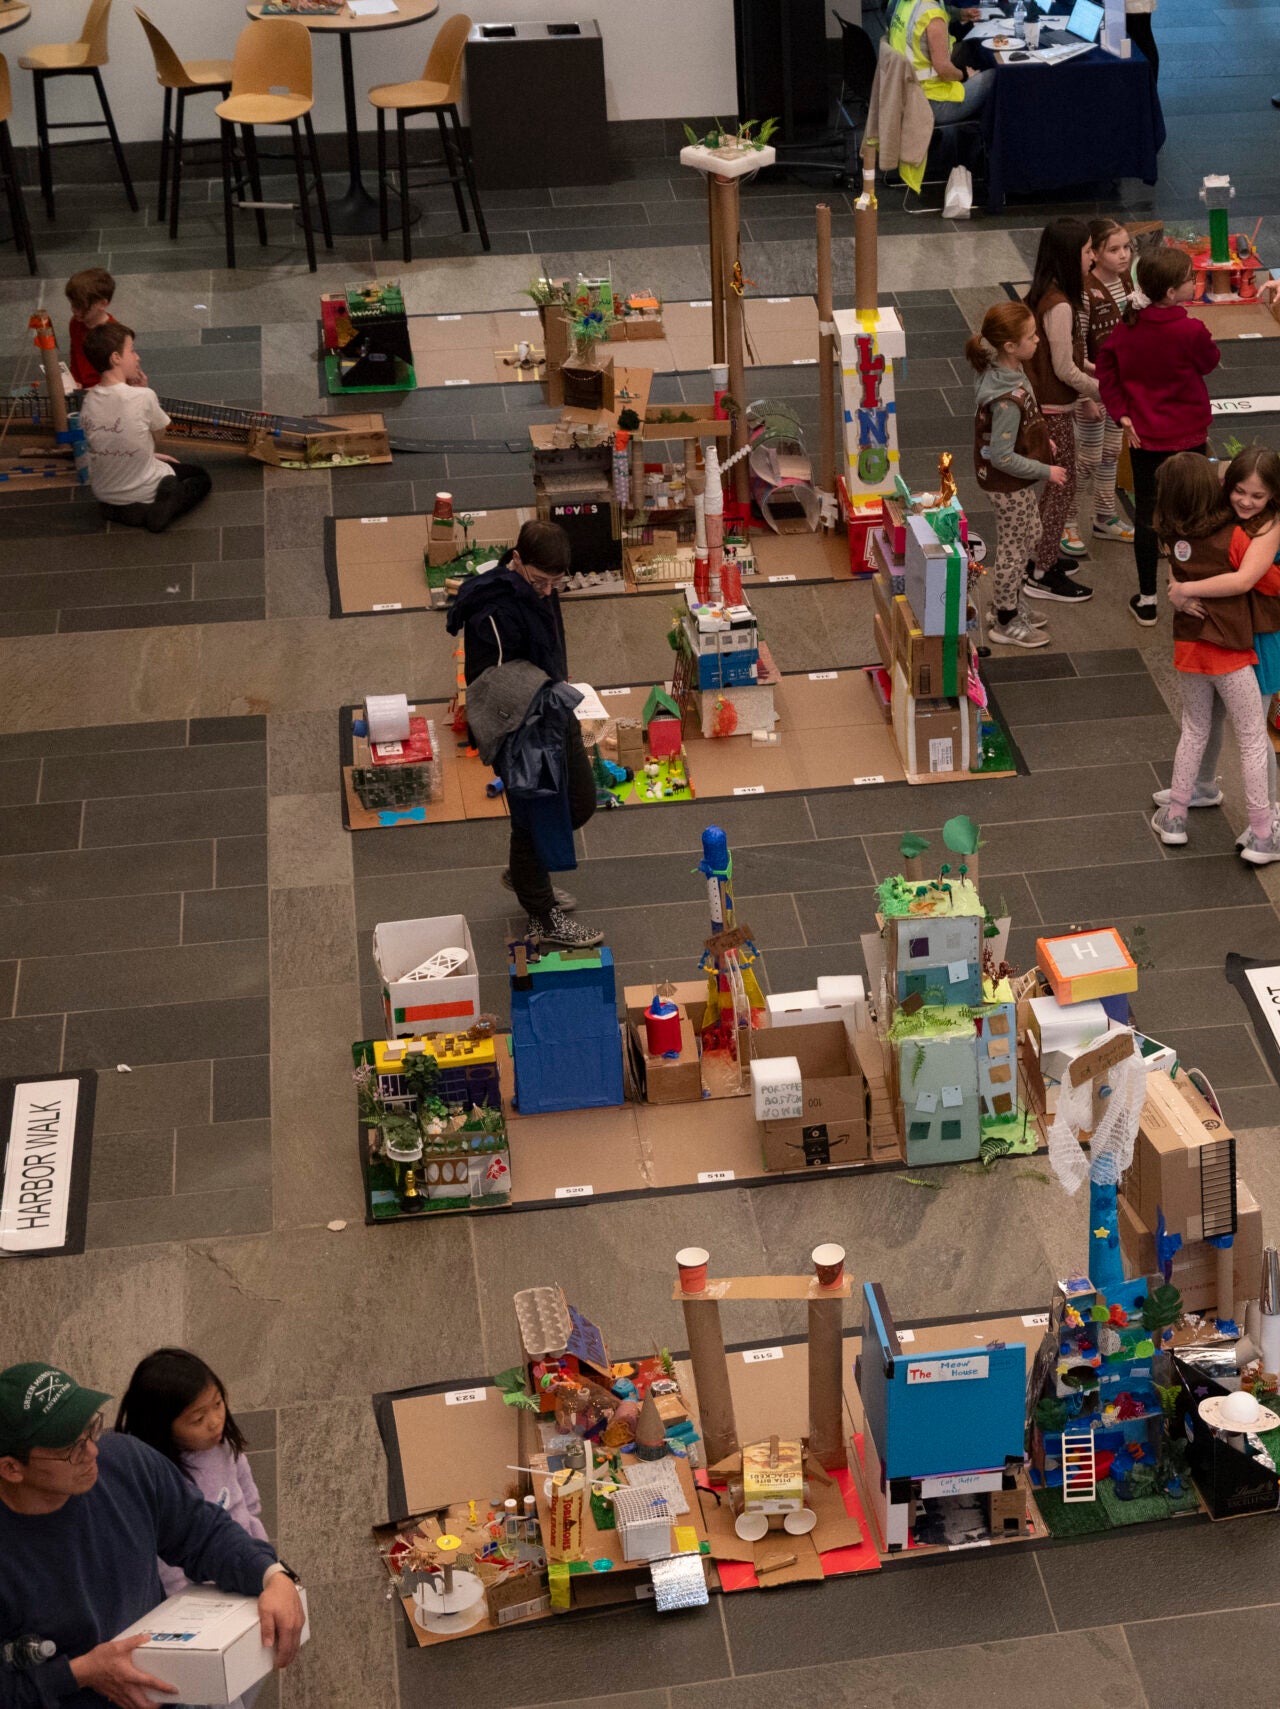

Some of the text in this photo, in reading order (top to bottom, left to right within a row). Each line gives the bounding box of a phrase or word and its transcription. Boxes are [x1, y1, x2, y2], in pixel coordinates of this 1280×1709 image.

[855, 334, 889, 483] LING
[555, 504, 598, 516] MOVIES
[1072, 941, 1099, 960] H
[16, 1100, 61, 1230] HARBOR WALK
[940, 1360, 970, 1369] Meow
[909, 1369, 932, 1380] The
[951, 1368, 978, 1377] House
[24, 1385, 36, 1410] GREEN
